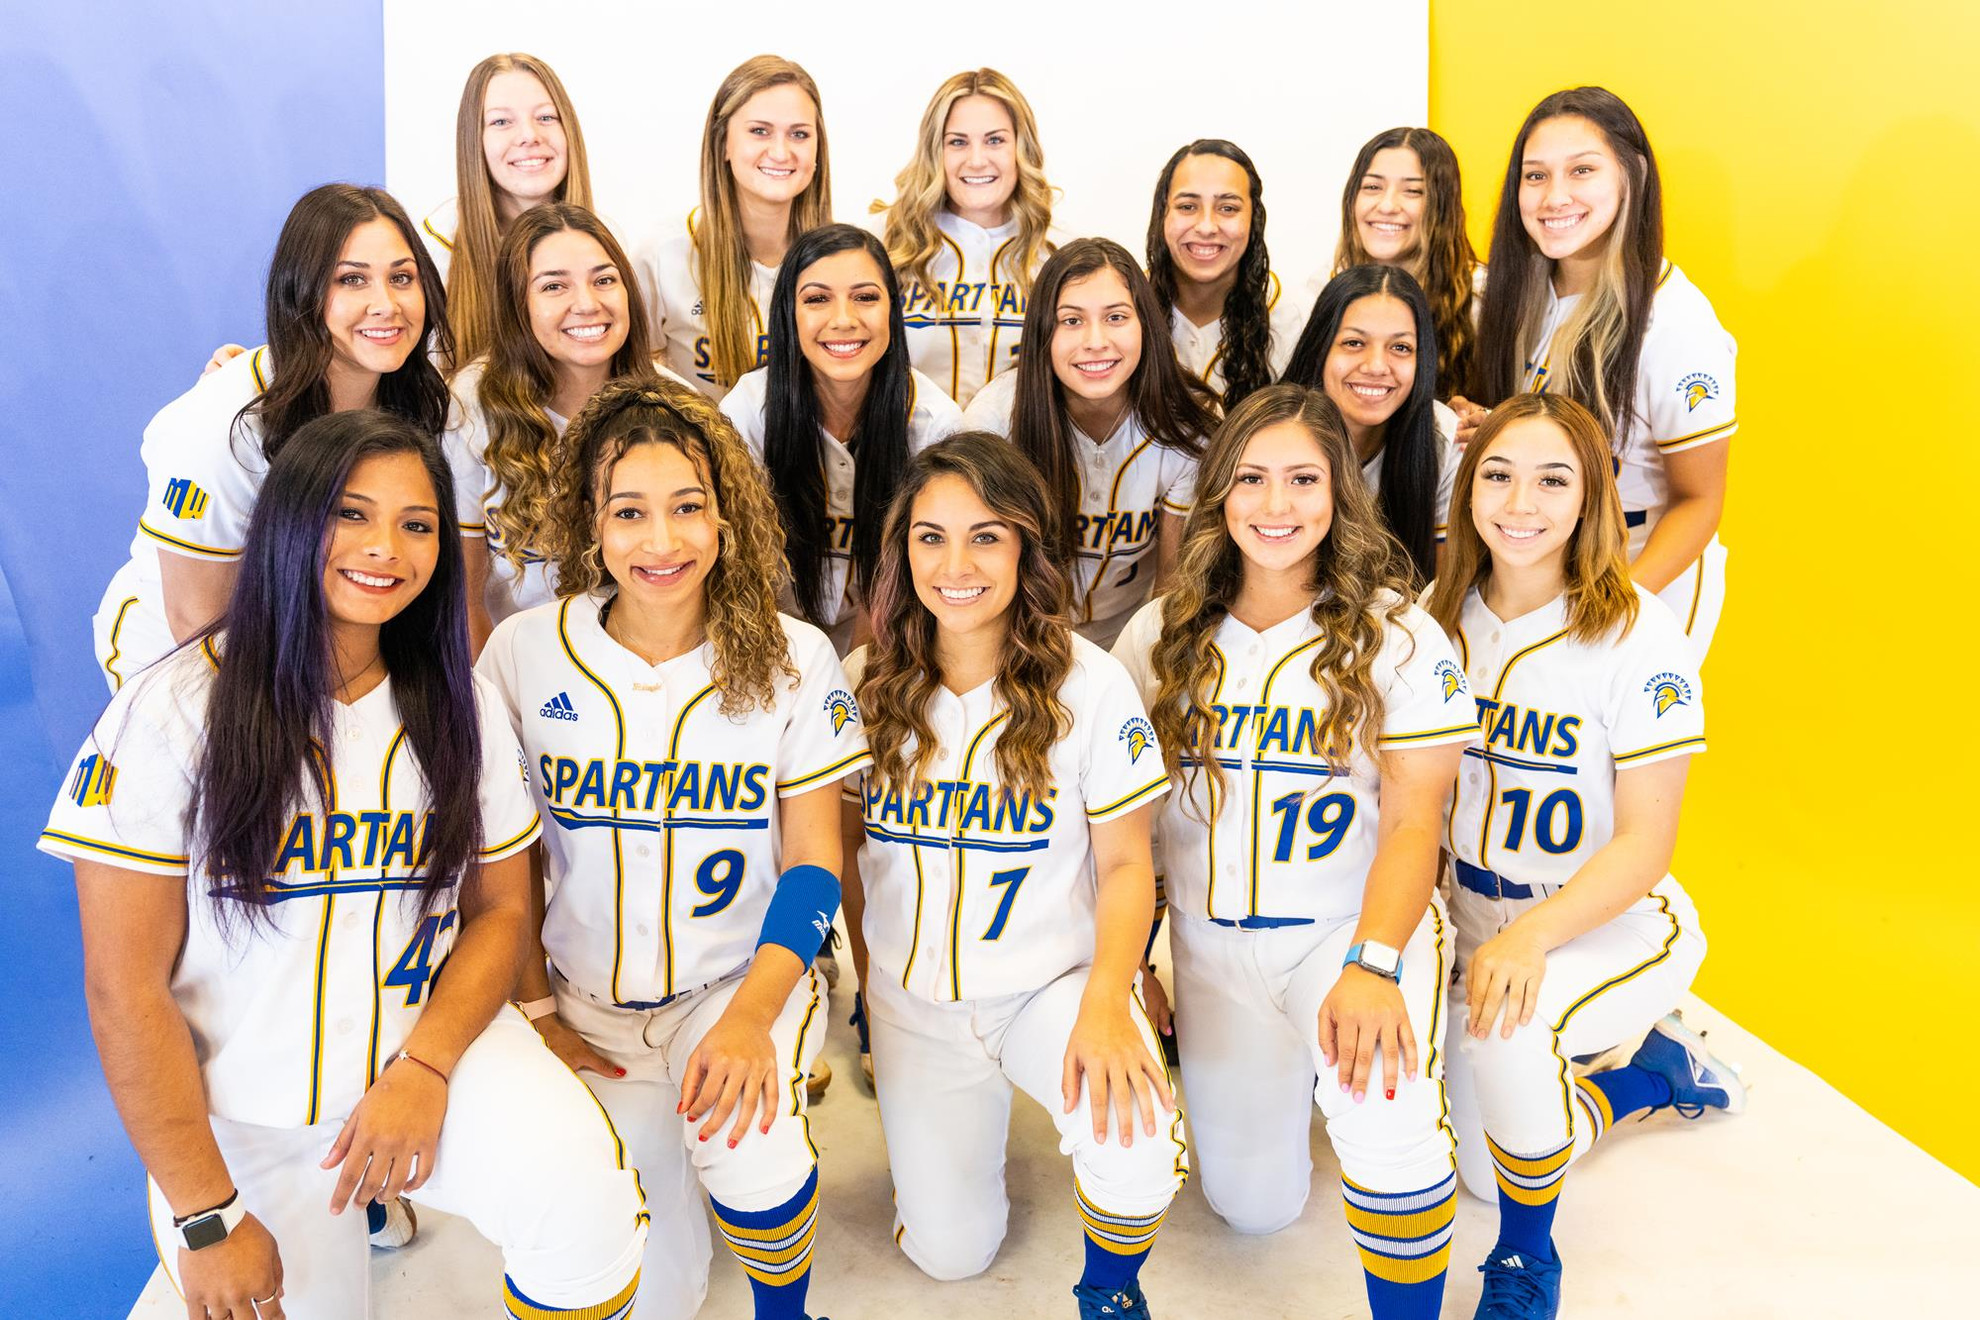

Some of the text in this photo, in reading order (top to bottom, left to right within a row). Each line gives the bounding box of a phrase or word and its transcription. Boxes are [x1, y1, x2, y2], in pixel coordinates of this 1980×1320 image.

[540, 707, 578, 722] adidas
[540, 752, 770, 813] SPARTANS
[1270, 791, 1357, 863] 19
[1500, 786, 1585, 854] 10
[689, 847, 748, 918] 9
[980, 865, 1033, 941] 7
